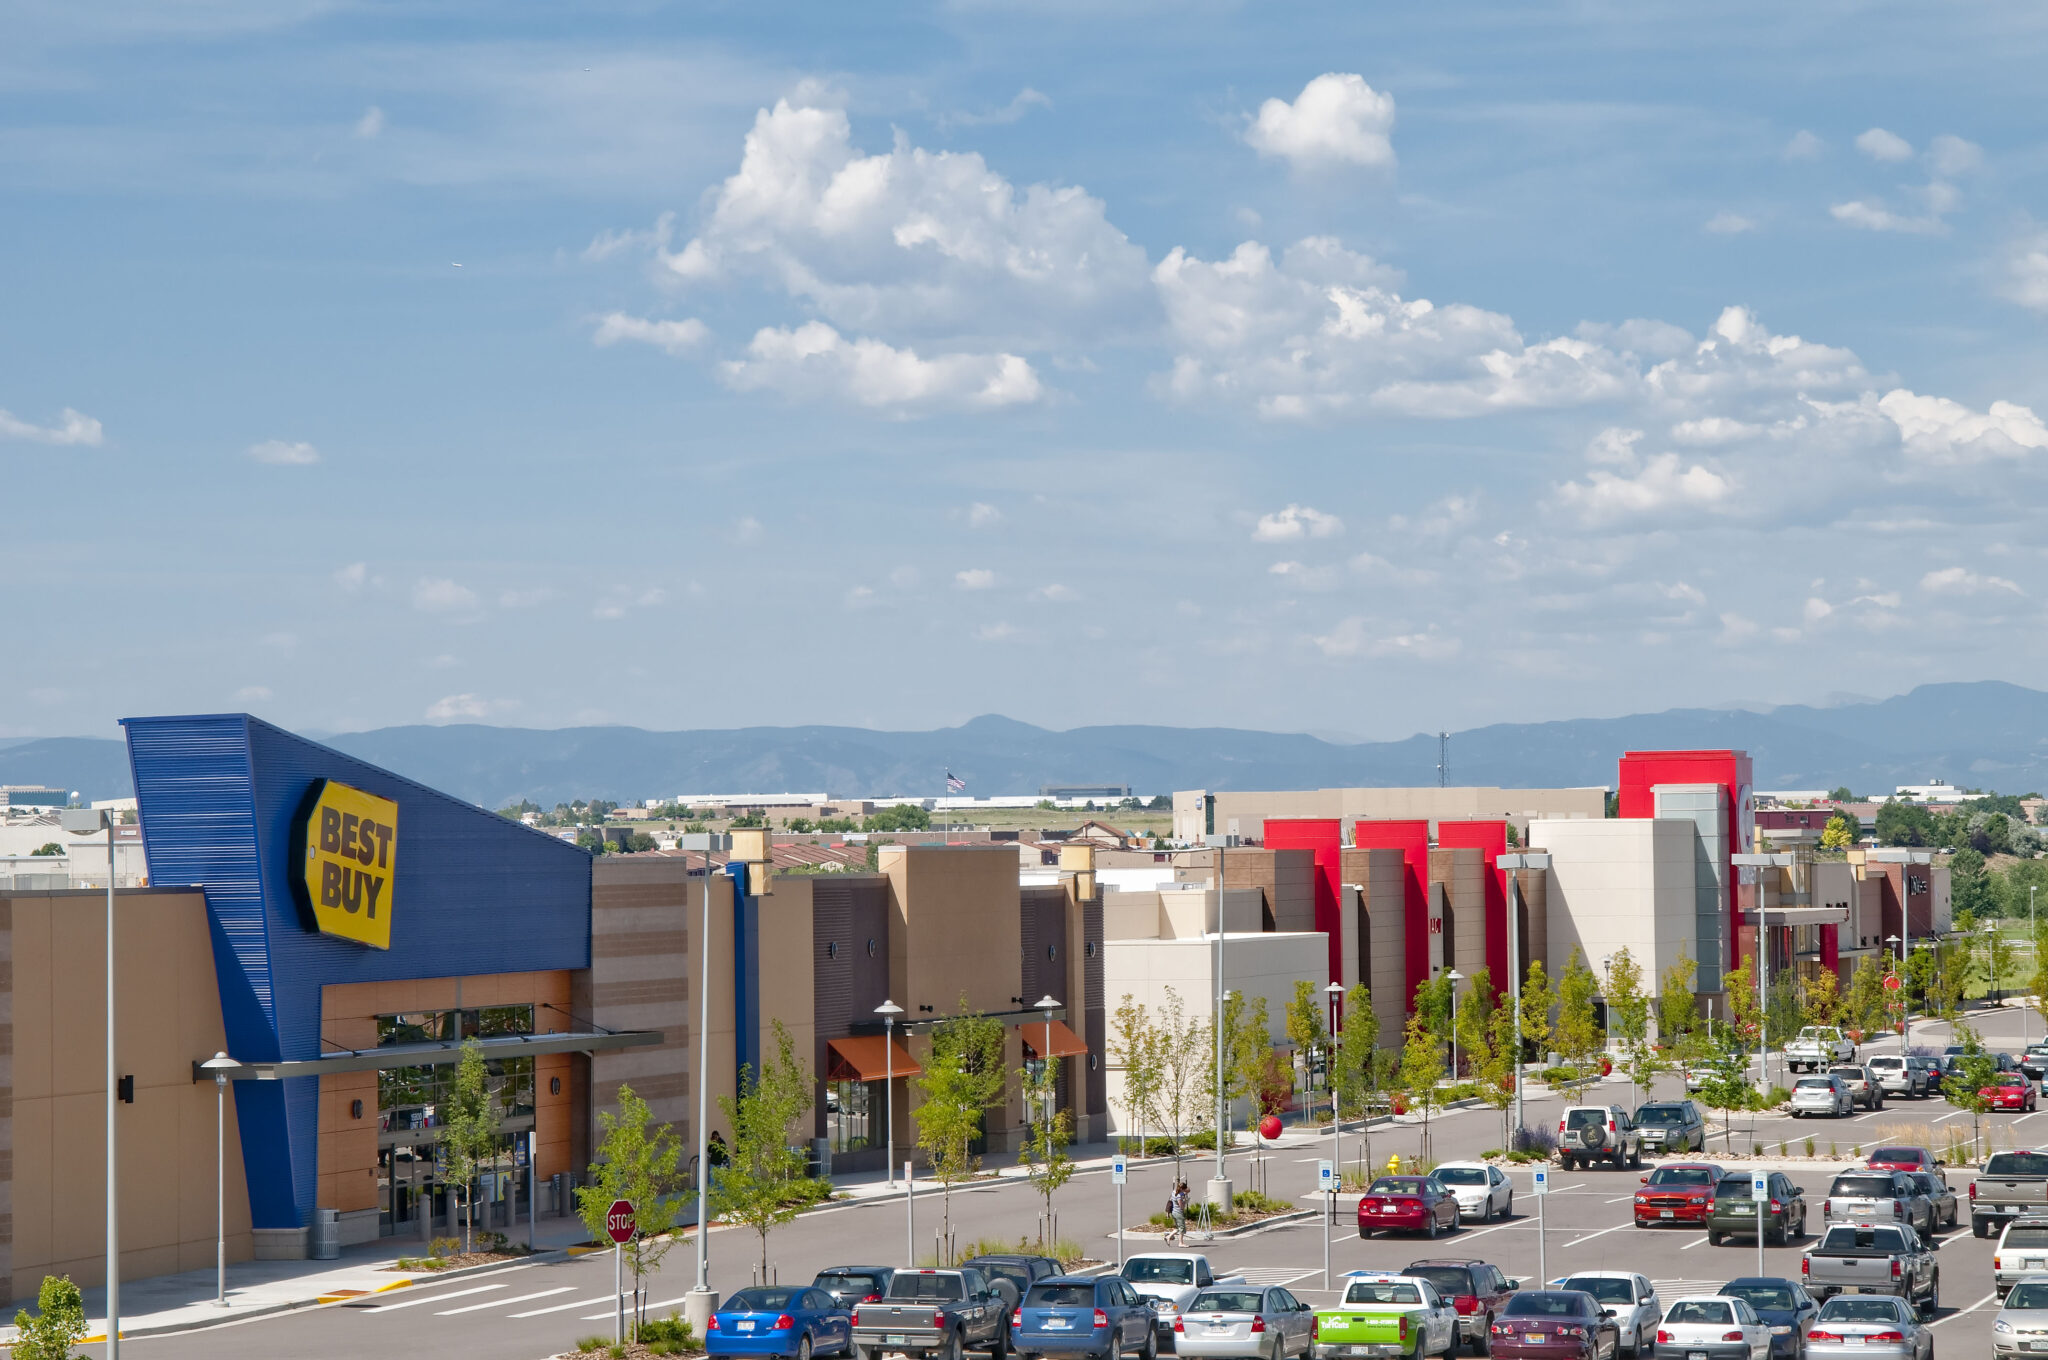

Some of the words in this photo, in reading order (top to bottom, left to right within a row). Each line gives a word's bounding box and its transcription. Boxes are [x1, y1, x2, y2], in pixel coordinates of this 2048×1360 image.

[320, 805, 393, 869] BEST
[321, 860, 385, 919] BUY
[609, 1214, 635, 1230] STOP
